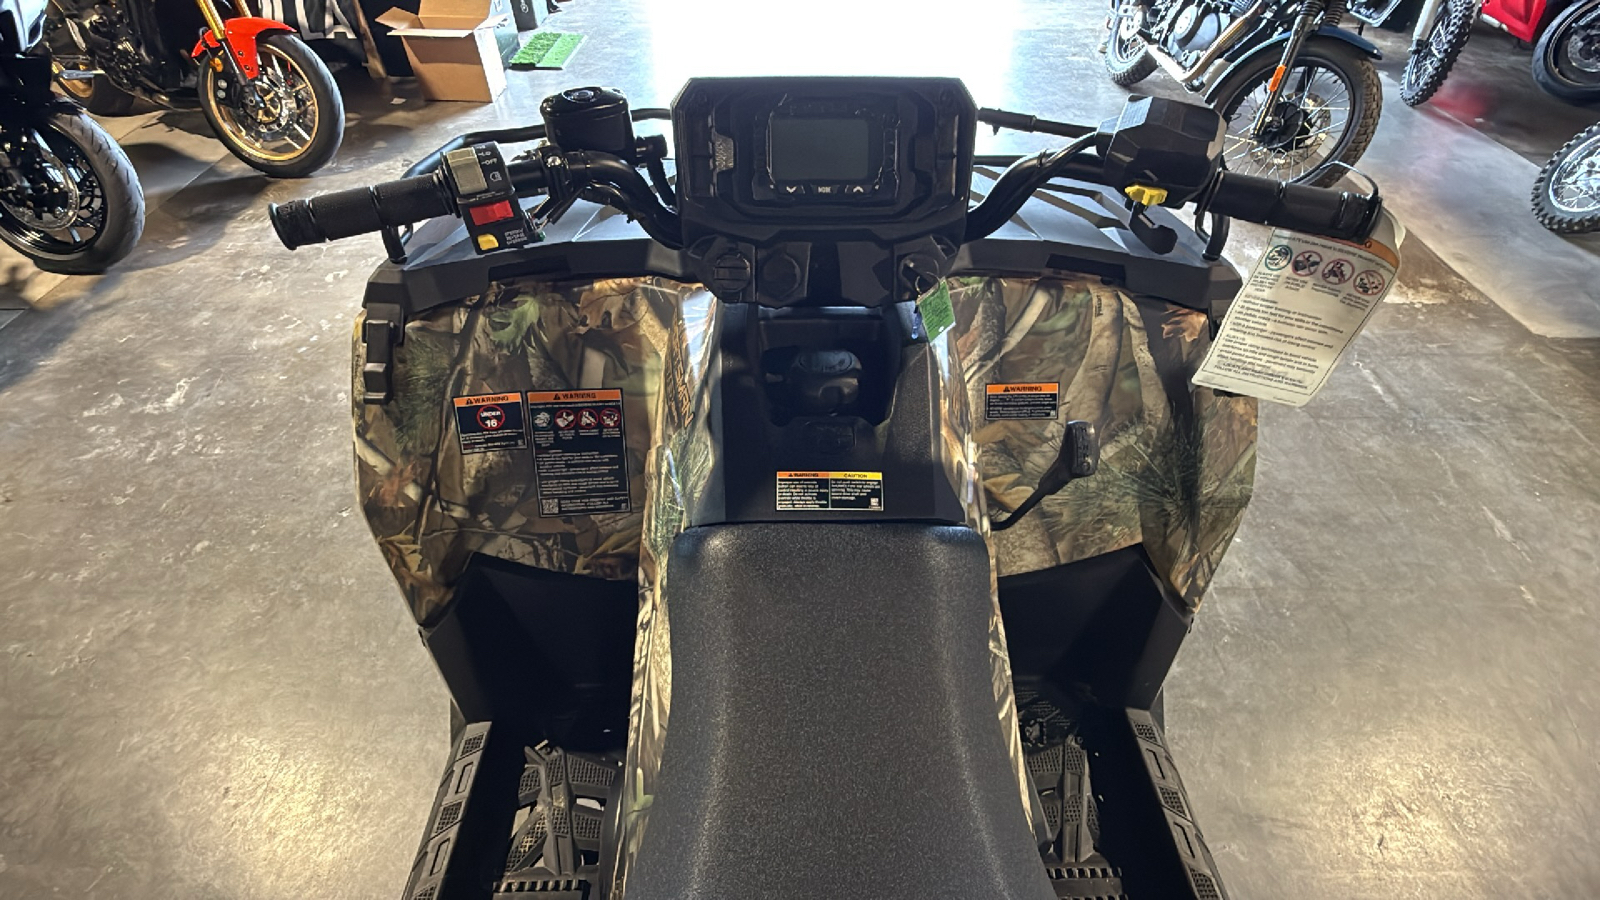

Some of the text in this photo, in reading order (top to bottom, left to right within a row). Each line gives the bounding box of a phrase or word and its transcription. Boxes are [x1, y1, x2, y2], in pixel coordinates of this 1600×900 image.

[473, 395, 509, 404] WARNING
[562, 392, 597, 400] WARNING
[480, 410, 501, 418] UNDER
[485, 419, 498, 427] 16
